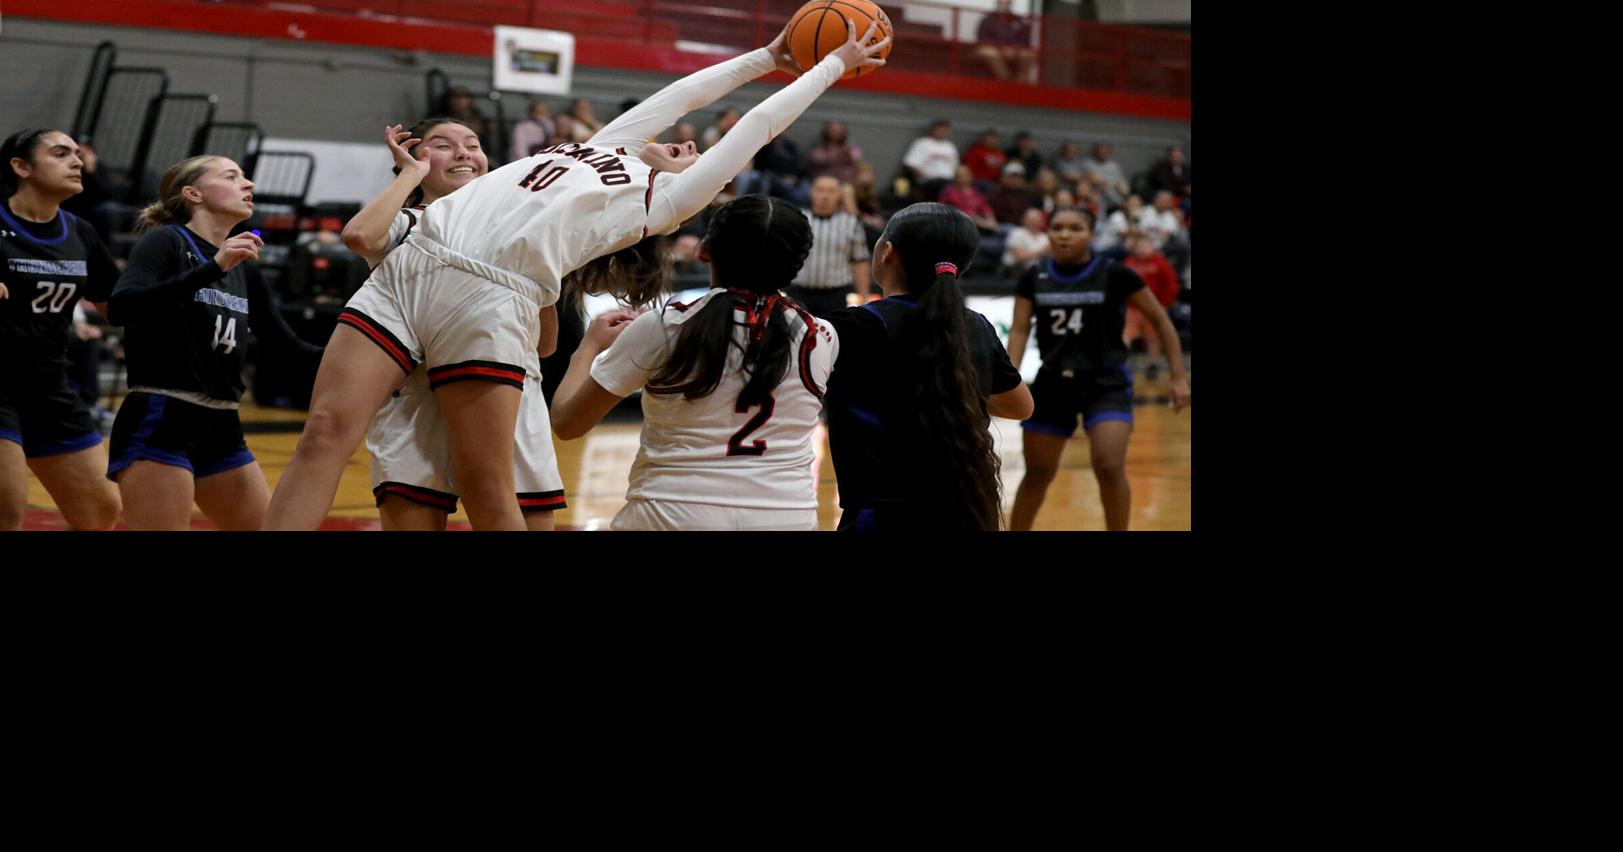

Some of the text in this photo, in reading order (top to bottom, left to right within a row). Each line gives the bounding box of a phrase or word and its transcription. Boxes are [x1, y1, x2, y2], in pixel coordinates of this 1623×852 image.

[518, 160, 570, 192] 40
[31, 281, 77, 314] 20
[211, 314, 237, 354] 14
[1050, 308, 1083, 335] 24
[726, 393, 776, 456] 2
